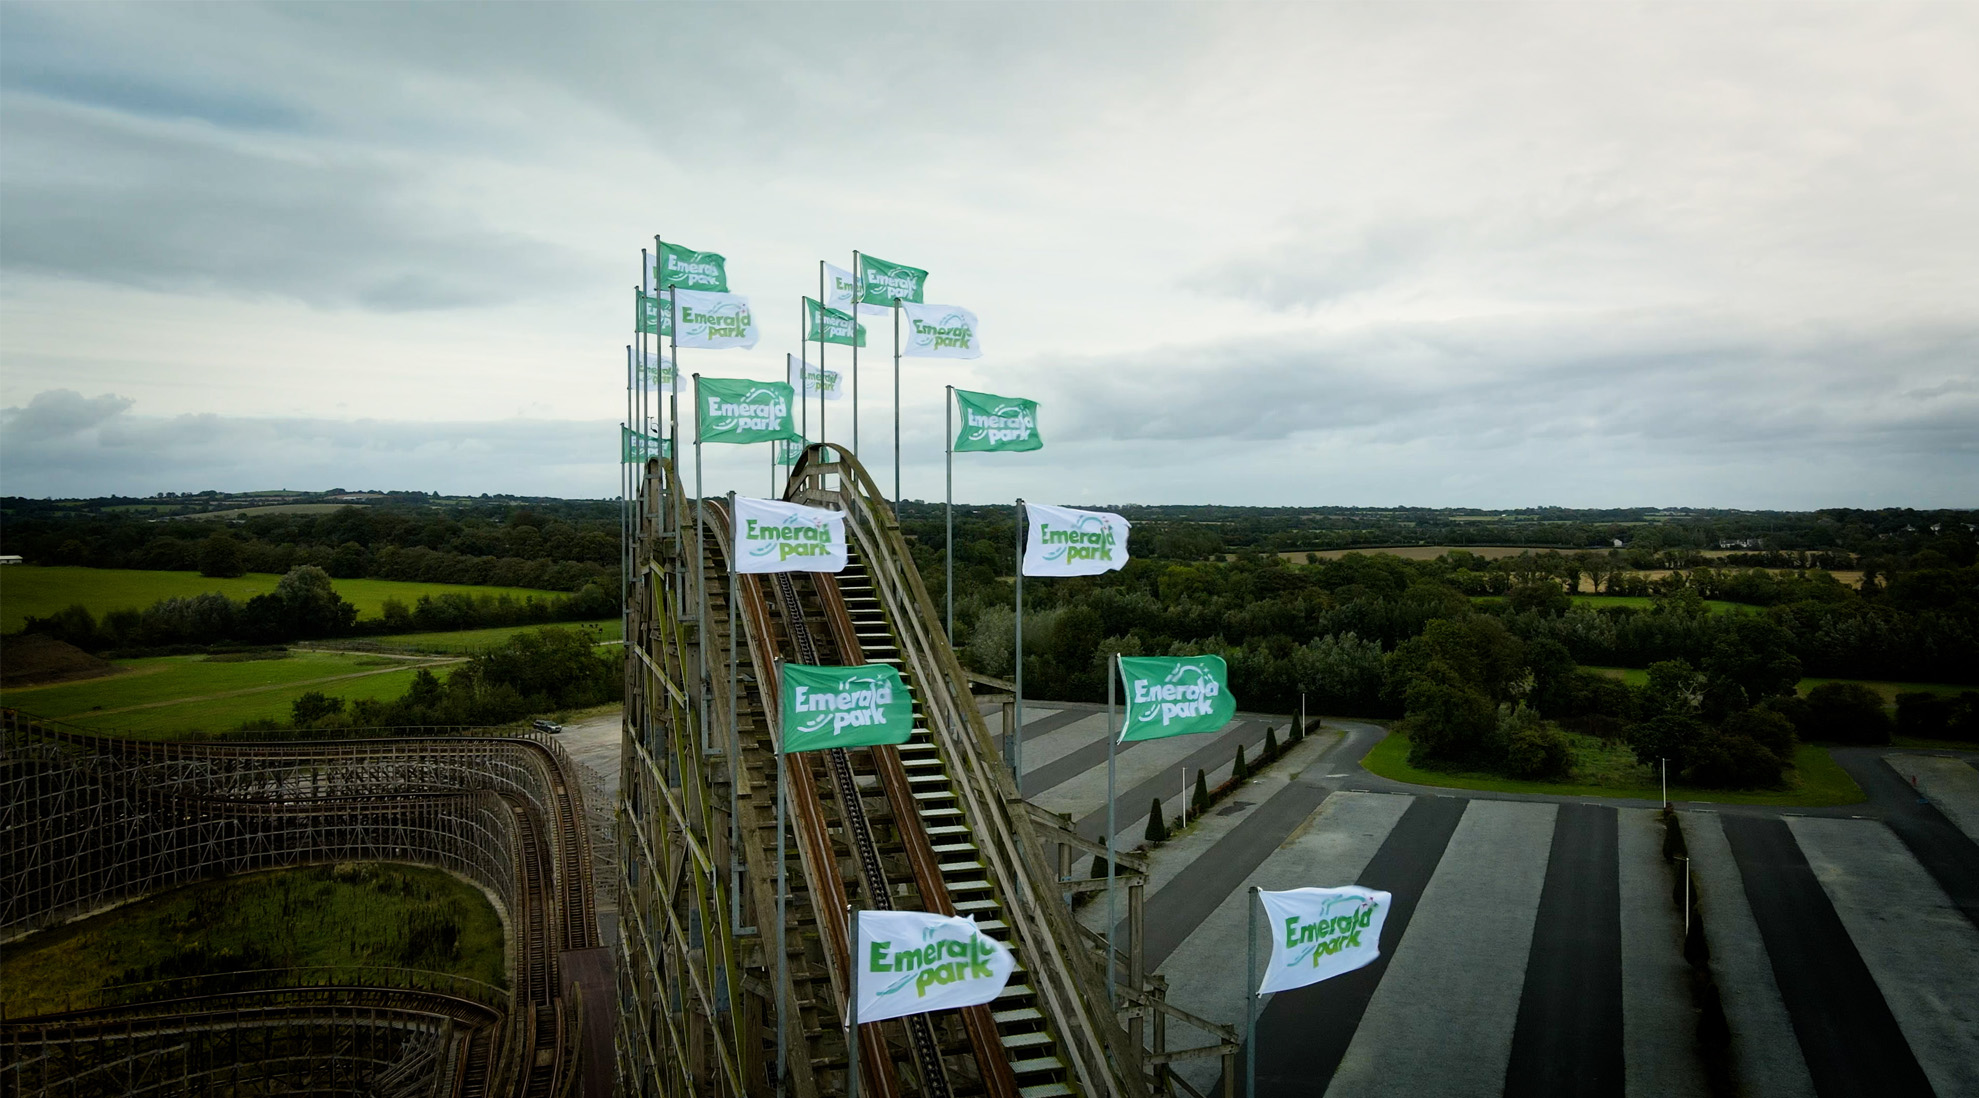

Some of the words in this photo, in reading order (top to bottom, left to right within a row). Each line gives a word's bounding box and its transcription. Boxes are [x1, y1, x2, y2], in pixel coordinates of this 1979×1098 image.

[668, 254, 719, 276] Emera
[887, 286, 914, 300] park
[682, 307, 751, 328] Emerald
[708, 326, 746, 340] park
[934, 336, 971, 350] park
[708, 396, 787, 417] Emerald
[736, 415, 781, 433] park
[988, 426, 1031, 445] park
[1040, 523, 1116, 546] Emerald
[779, 541, 831, 561] park
[1066, 545, 1112, 565] park
[795, 679, 893, 713] Emerald
[833, 707, 887, 736] park
[1161, 699, 1213, 726] park
[1285, 902, 1378, 950] Emerald
[1312, 930, 1362, 969] park
[915, 957, 994, 998] park
